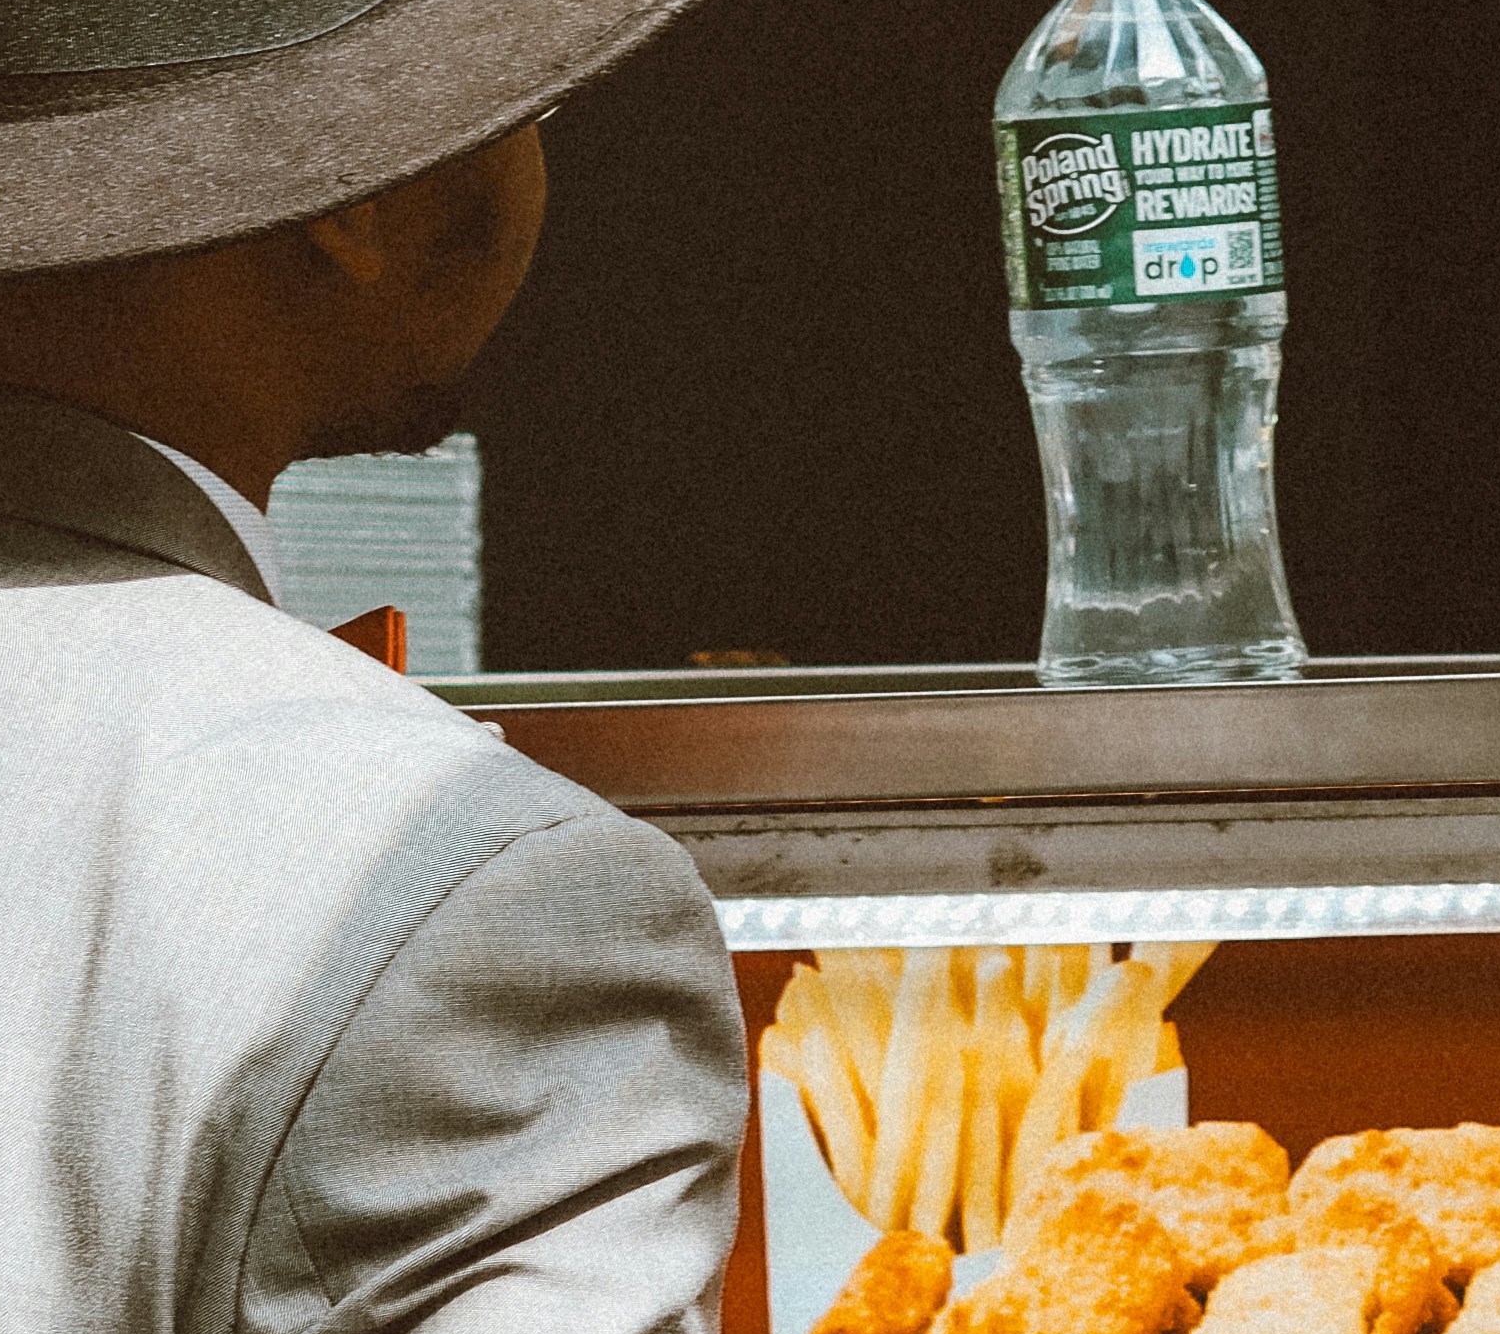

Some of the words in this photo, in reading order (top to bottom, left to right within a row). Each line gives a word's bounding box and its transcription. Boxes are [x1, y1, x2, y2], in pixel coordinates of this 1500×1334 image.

[1021, 132, 1120, 192] Poland
[1131, 121, 1254, 166] HYDRATE
[1026, 169, 1126, 227] Spring
